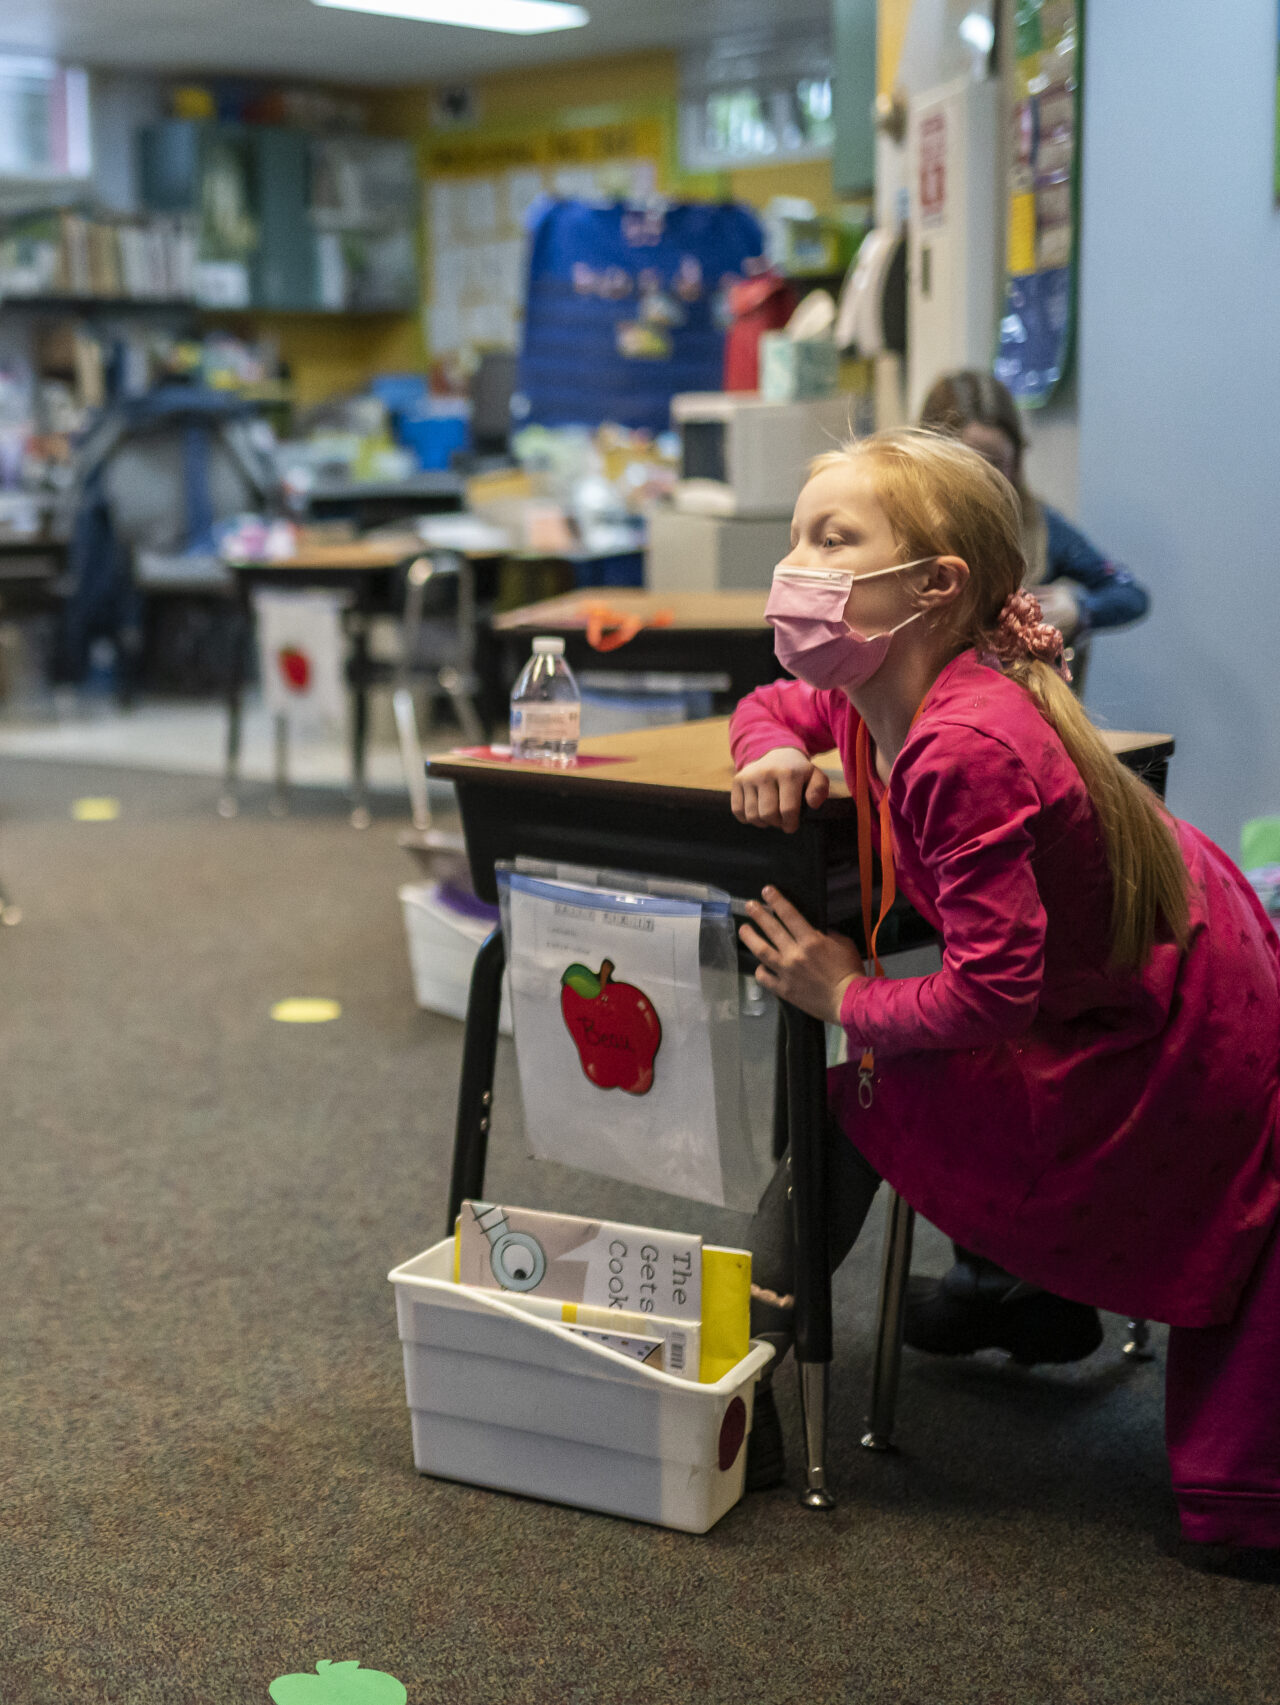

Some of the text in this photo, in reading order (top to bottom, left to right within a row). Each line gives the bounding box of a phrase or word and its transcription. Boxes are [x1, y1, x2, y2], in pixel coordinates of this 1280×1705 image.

[608, 1239, 629, 1310] Cook
[639, 1244, 660, 1314] Gets
[672, 1251, 693, 1306] The
